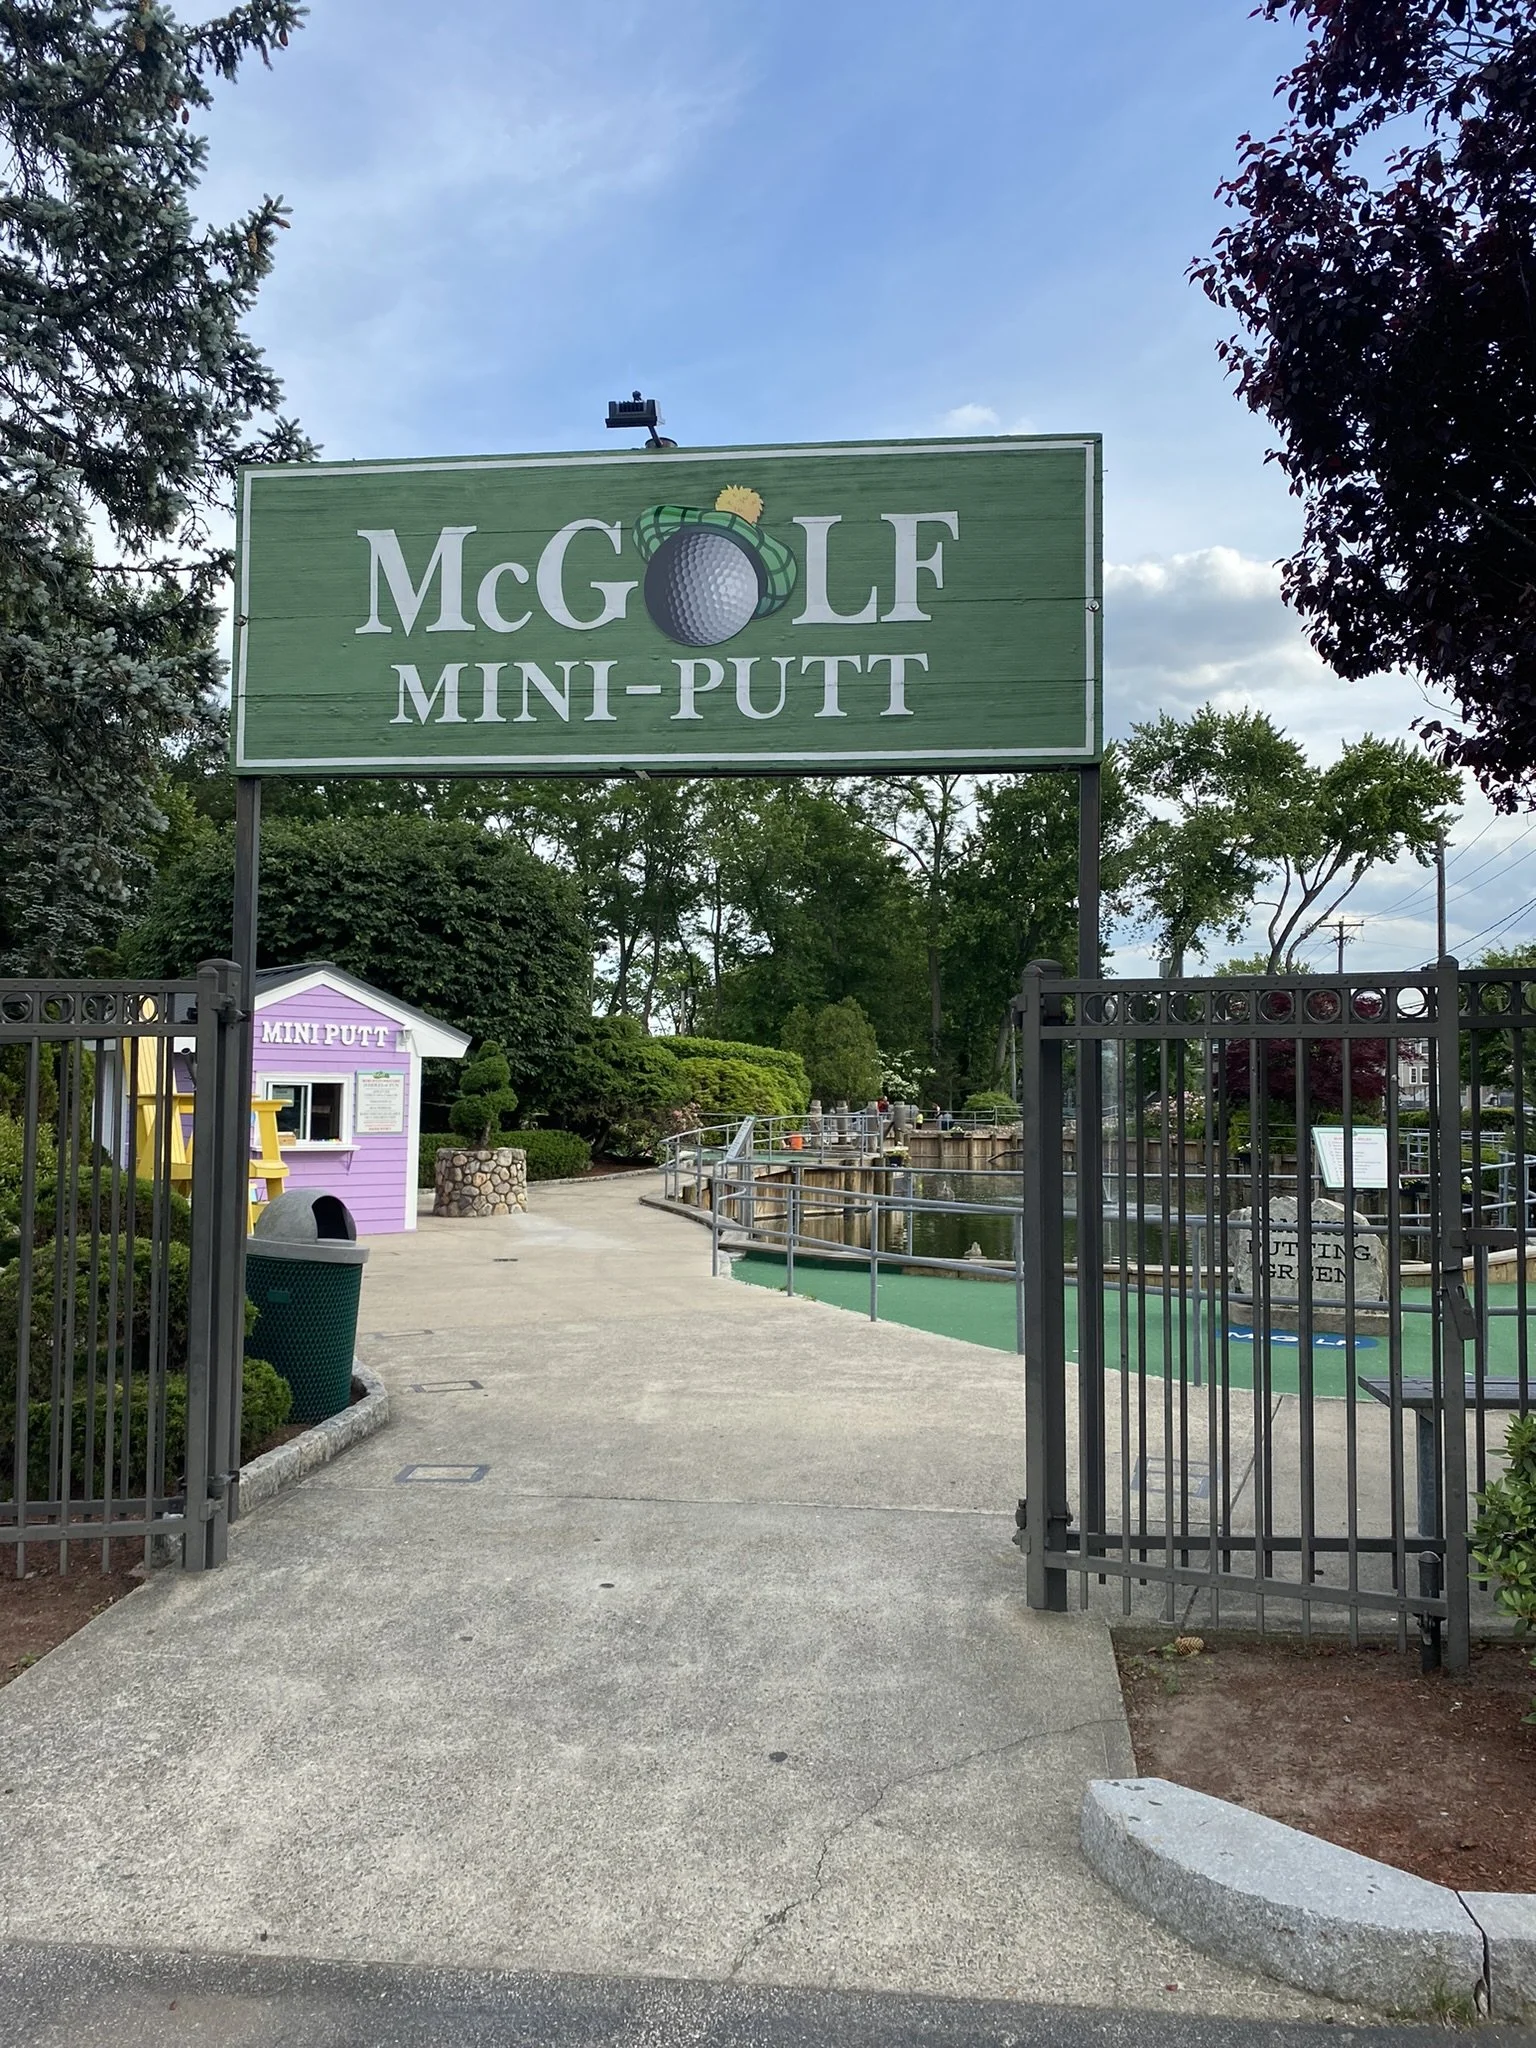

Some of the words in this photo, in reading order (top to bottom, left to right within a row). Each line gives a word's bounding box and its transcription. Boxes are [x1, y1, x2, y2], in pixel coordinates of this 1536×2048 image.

[389, 652, 929, 725] MINI-PUTT
[262, 1020, 319, 1044] MINI
[324, 1023, 389, 1047] PUTT
[1246, 1240, 1371, 1260] PUTING
[1260, 1264, 1353, 1283] GREN
